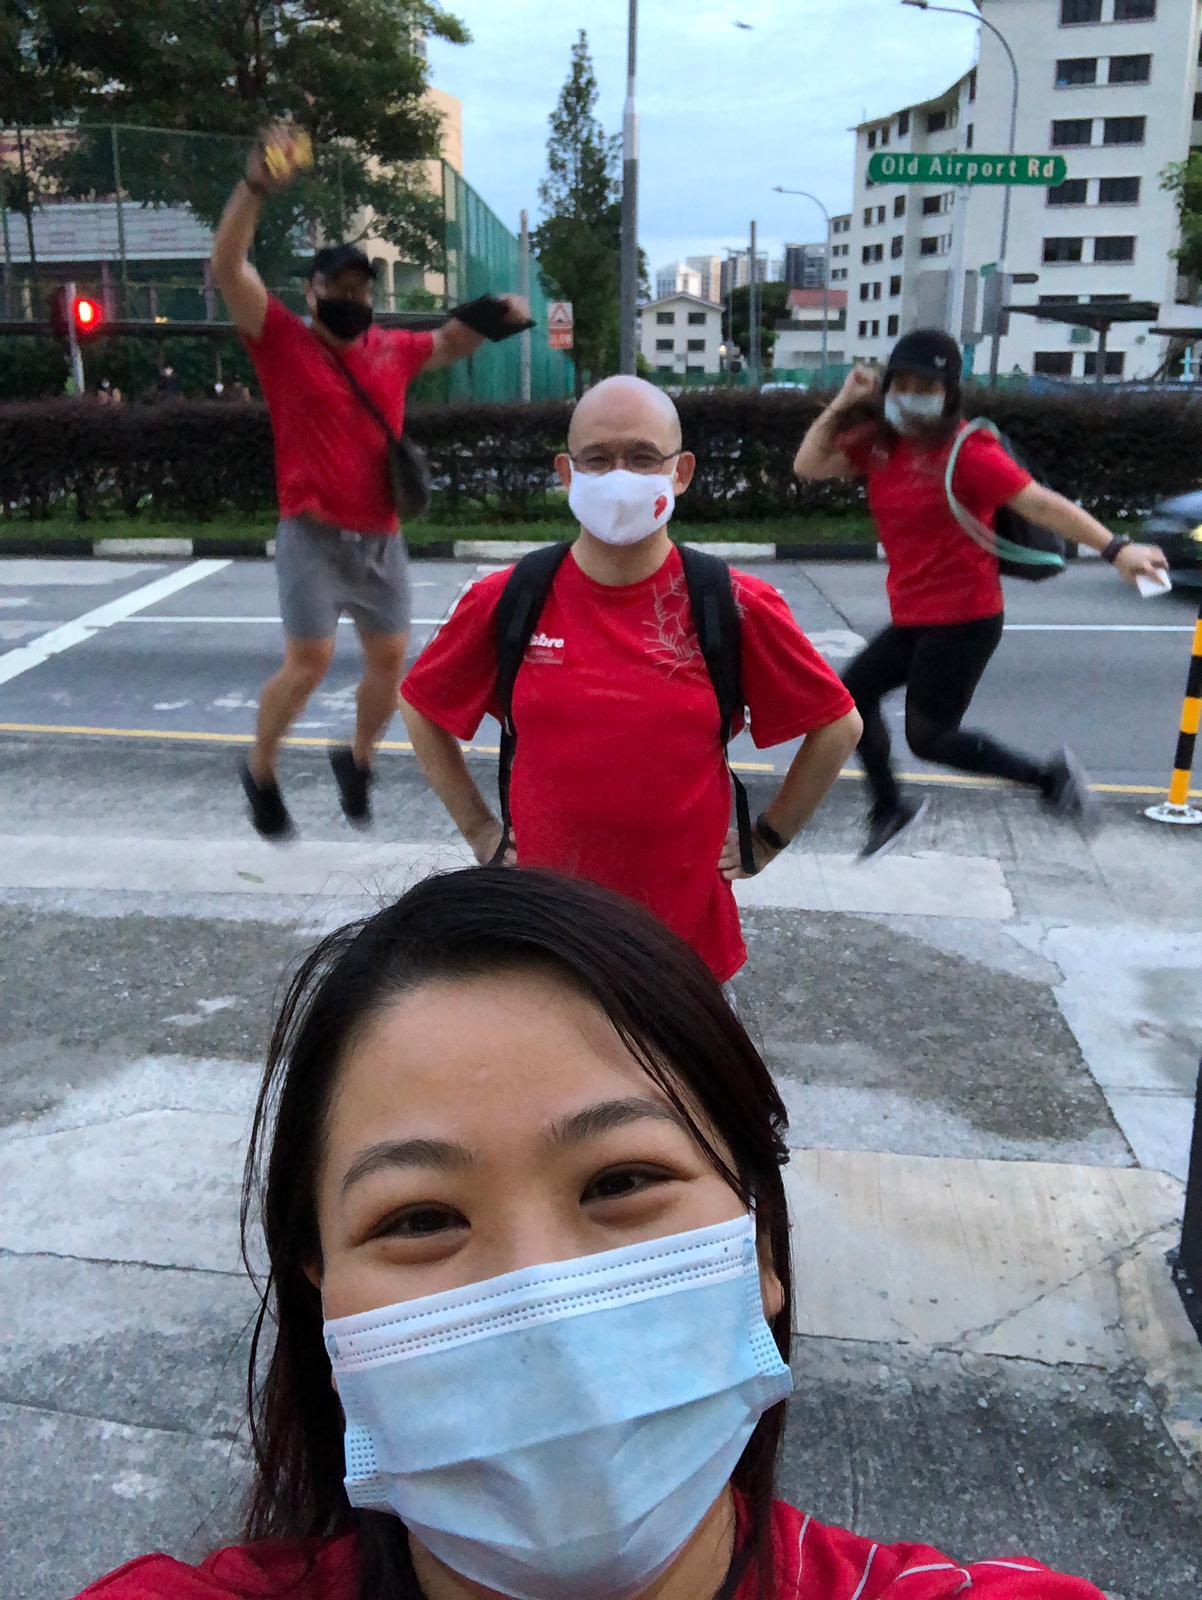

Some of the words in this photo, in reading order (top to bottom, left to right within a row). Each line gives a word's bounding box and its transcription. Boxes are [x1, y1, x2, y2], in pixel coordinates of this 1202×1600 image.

[881, 156, 919, 176] Old
[929, 157, 1017, 181] Airport
[1028, 158, 1055, 178] Rd
